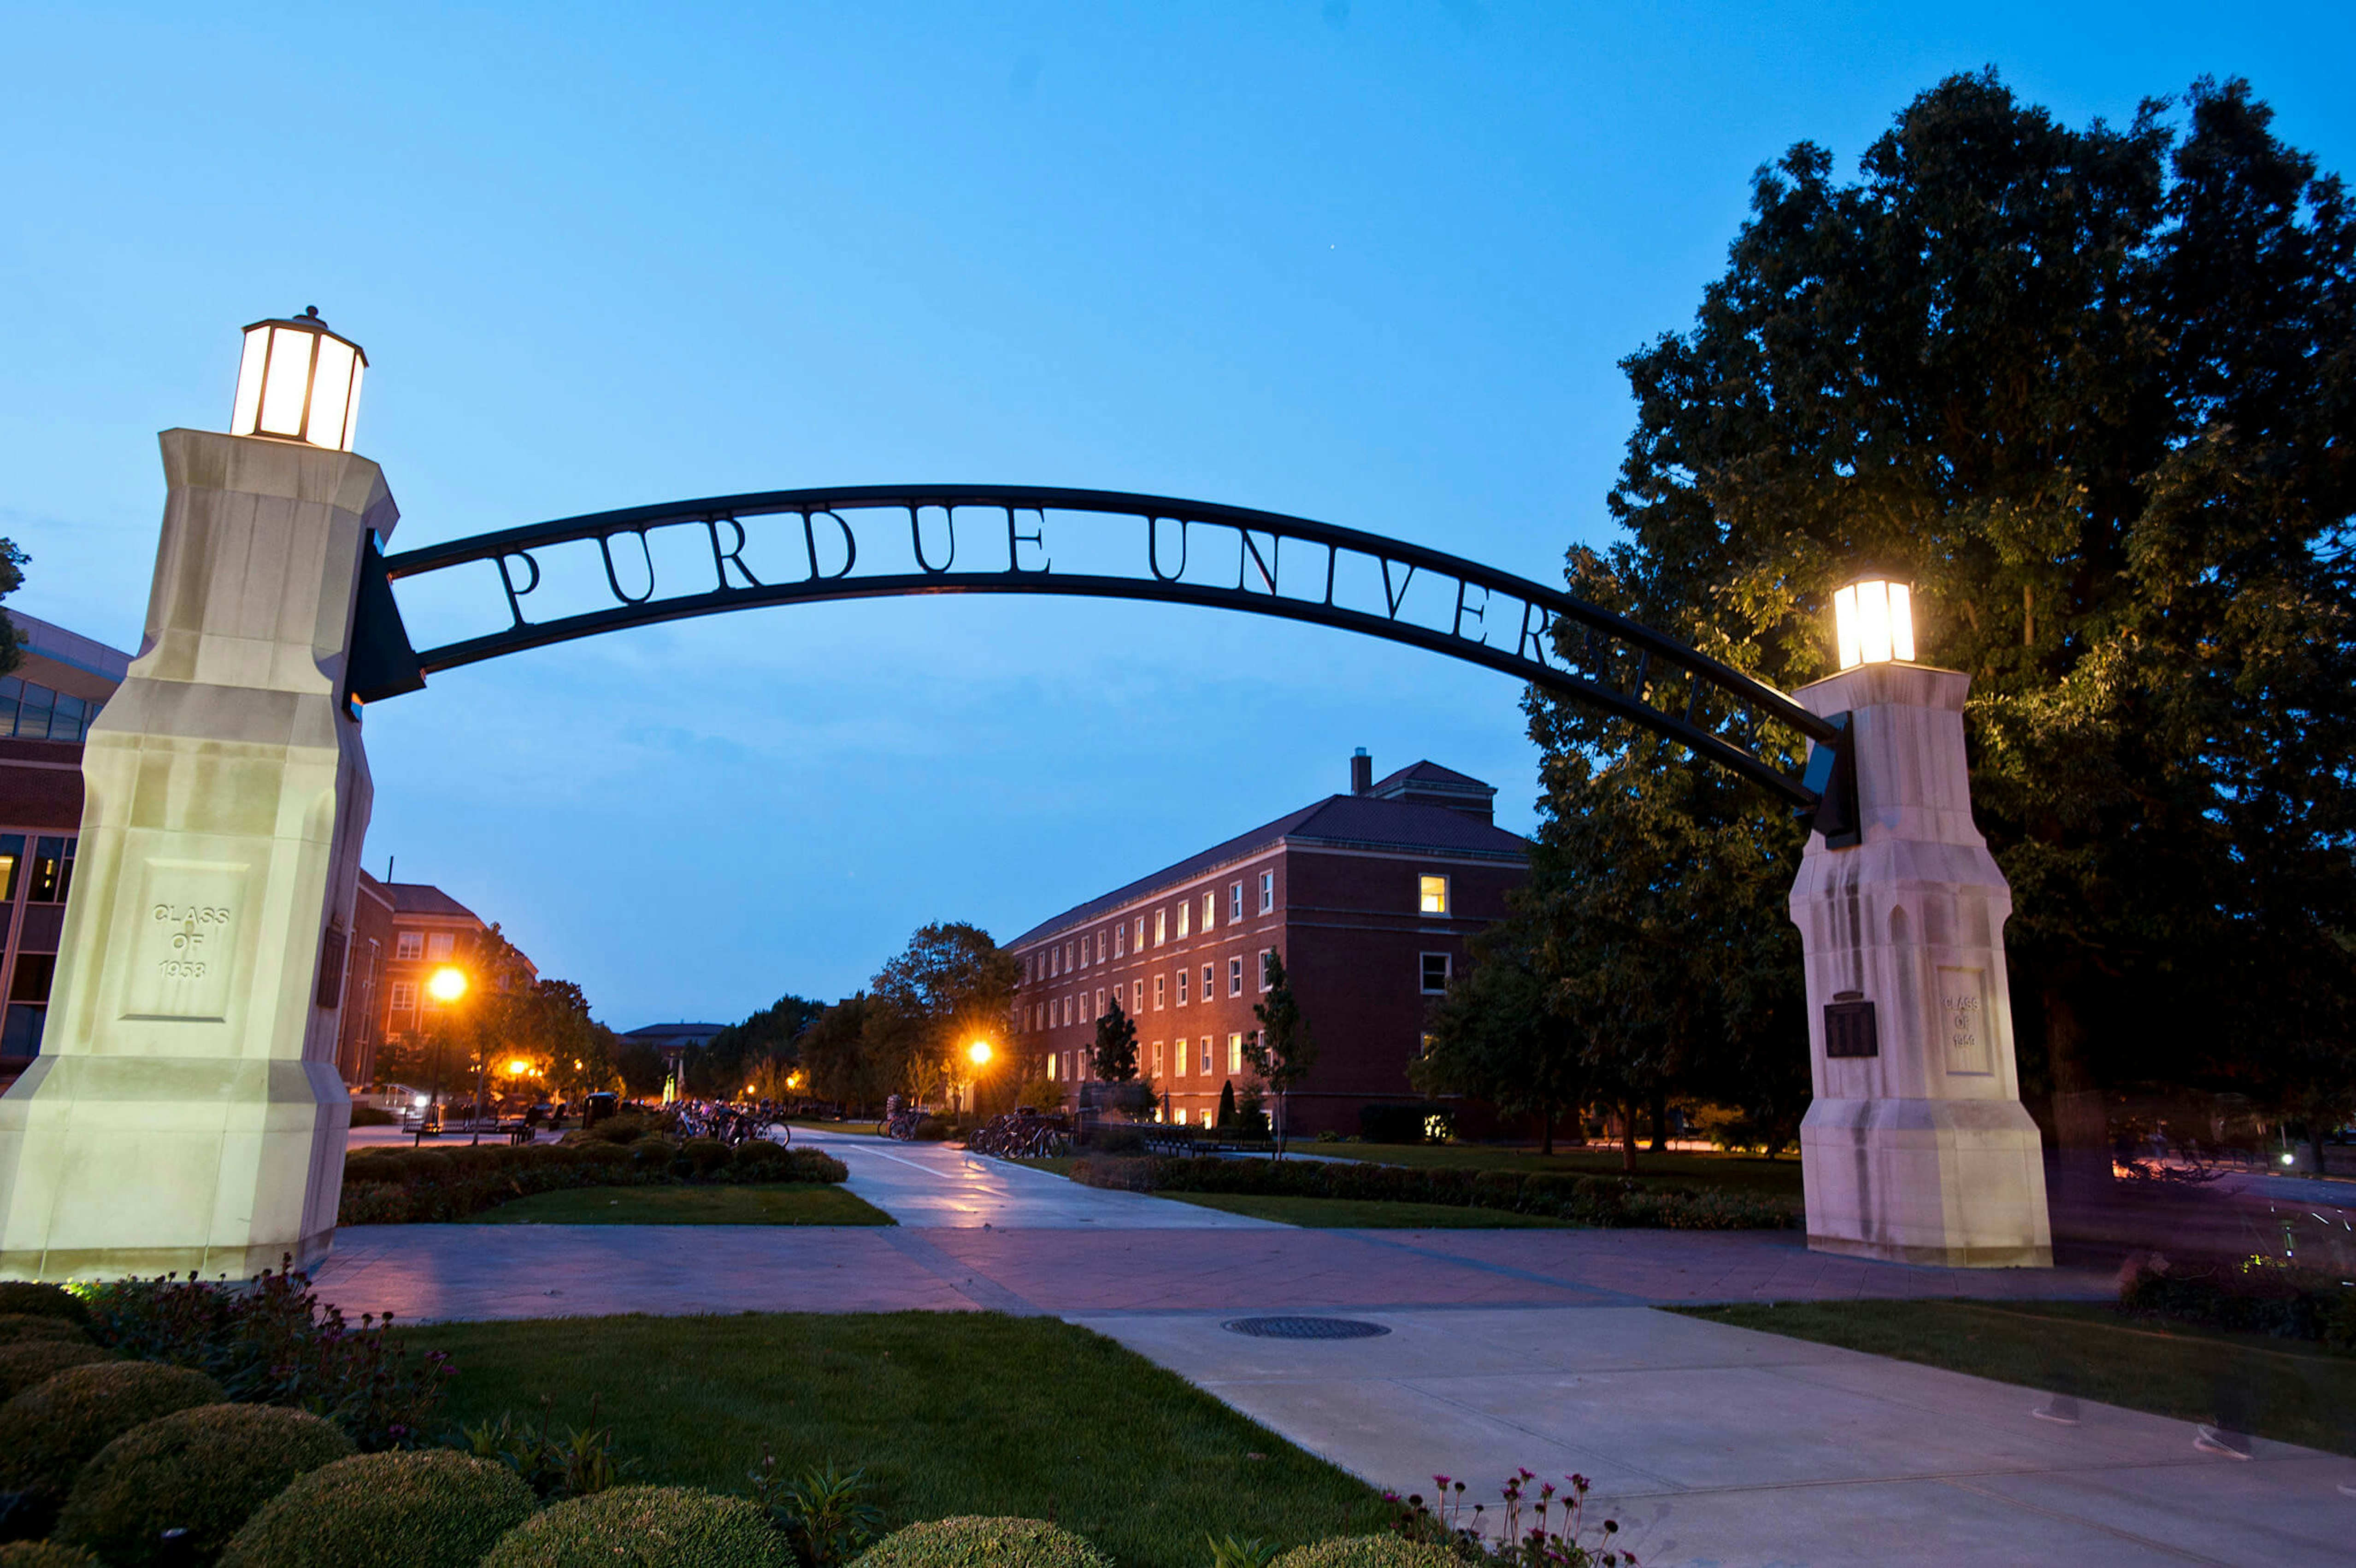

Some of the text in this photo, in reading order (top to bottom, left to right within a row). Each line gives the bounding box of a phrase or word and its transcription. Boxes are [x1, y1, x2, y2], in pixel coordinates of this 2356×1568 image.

[493, 504, 1051, 627] PURDUE
[154, 904, 230, 924] CLASS
[171, 933, 204, 949] OF
[1943, 996, 1980, 1010] CLASS
[1955, 1015, 1970, 1030] OF
